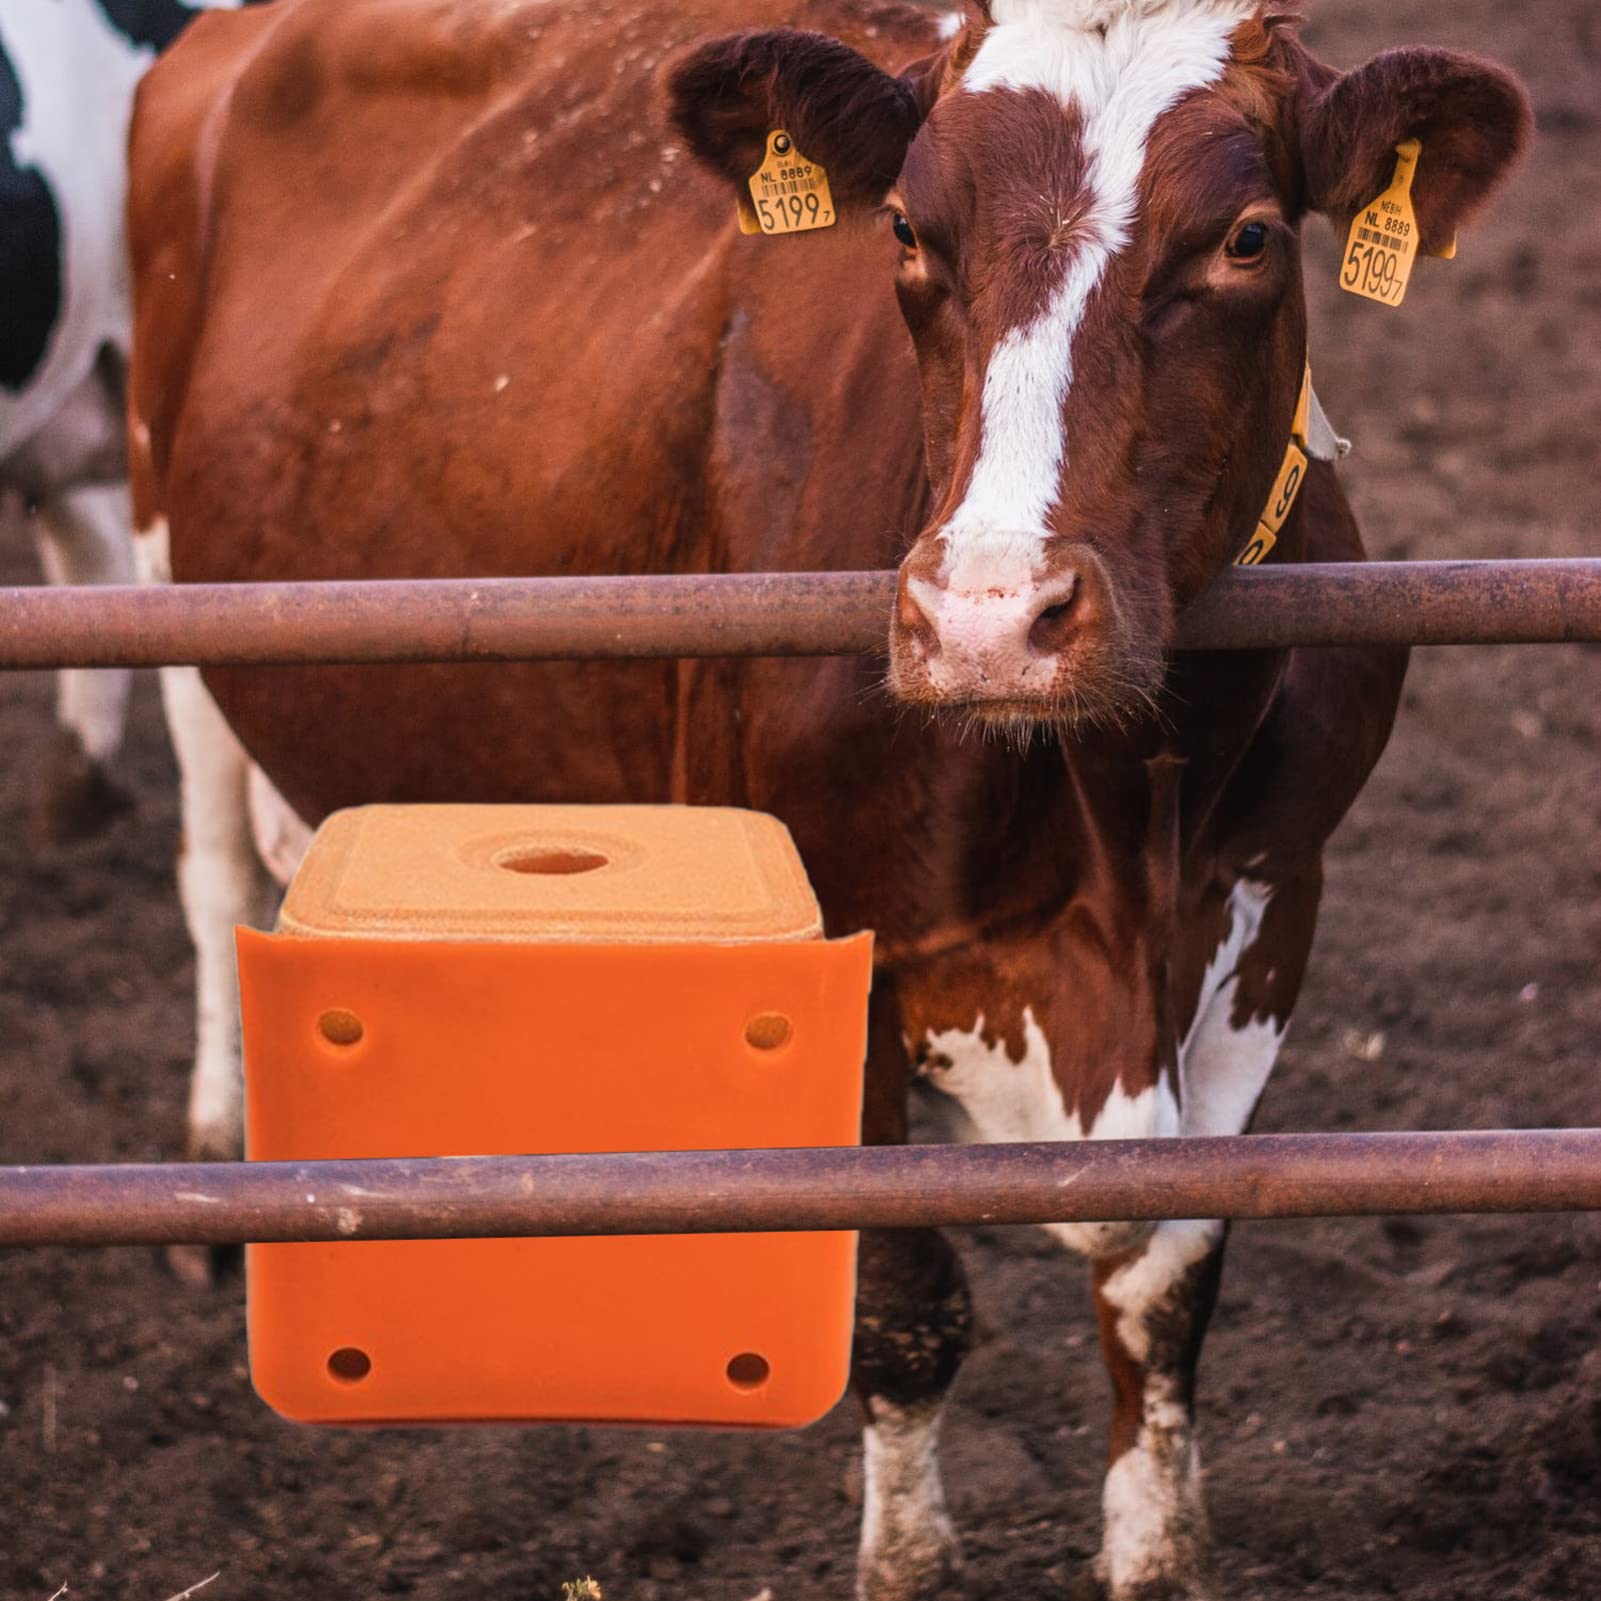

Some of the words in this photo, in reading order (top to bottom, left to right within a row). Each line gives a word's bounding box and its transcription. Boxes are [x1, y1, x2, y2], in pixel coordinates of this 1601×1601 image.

[760, 171, 777, 184] NL
[781, 165, 812, 181] 8889
[1364, 210, 1380, 228] NL
[1384, 217, 1410, 237] 8889
